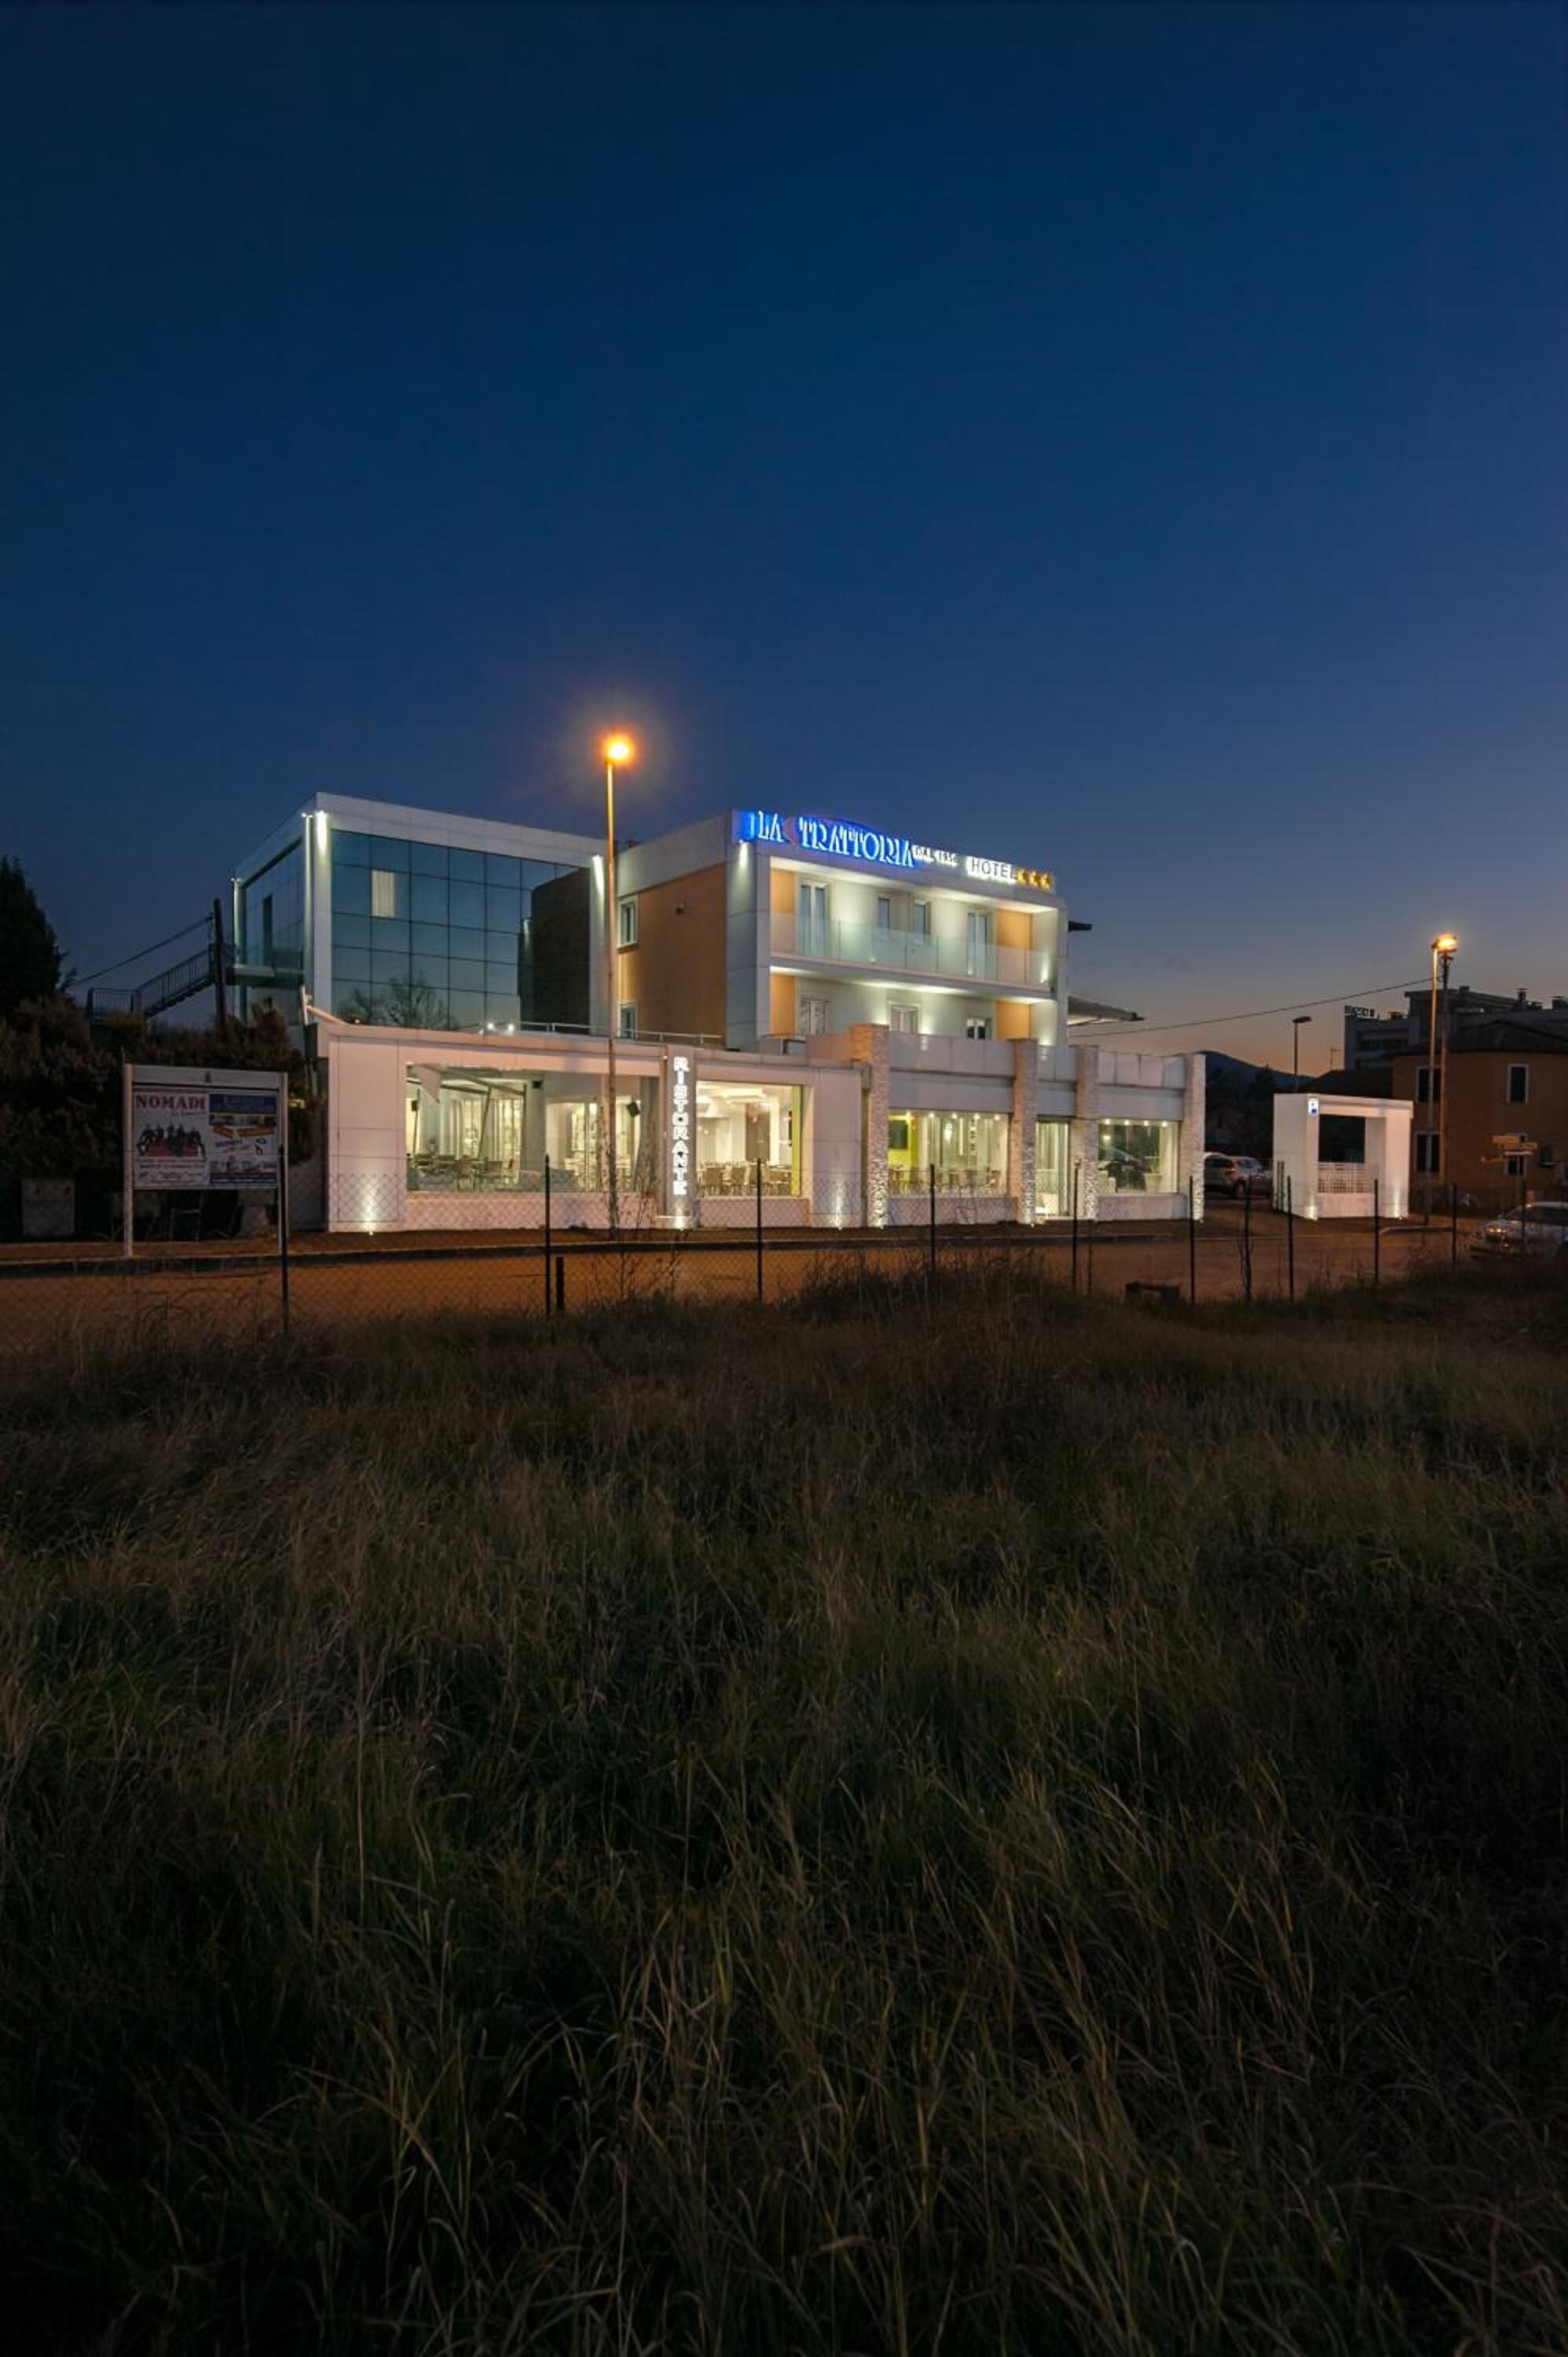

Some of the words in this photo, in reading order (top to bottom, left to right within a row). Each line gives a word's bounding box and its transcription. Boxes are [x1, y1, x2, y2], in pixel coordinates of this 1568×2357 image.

[758, 810, 784, 843] LA
[799, 816, 914, 867] TRATTORIA
[970, 857, 1018, 882] HOTEL
[136, 1095, 205, 1109] NOMADI
[672, 1056, 690, 1195] RISTORANTE
